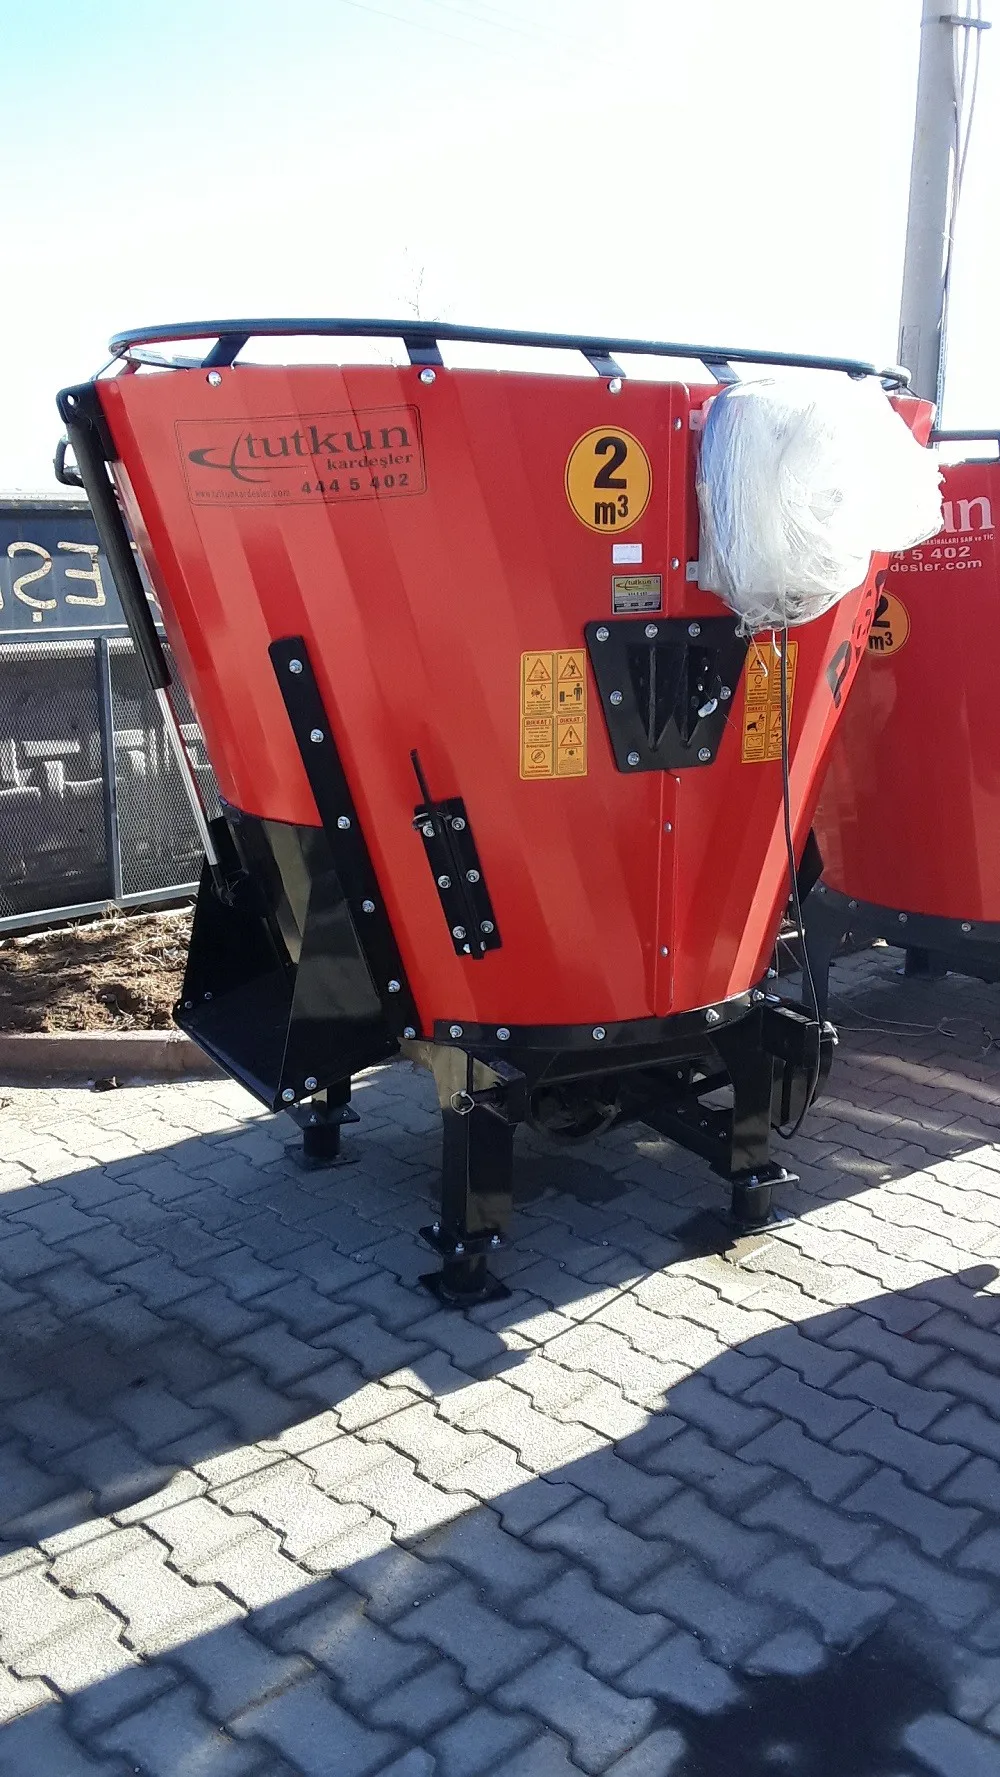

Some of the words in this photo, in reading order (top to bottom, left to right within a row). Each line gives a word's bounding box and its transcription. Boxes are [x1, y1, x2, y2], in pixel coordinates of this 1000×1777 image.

[244, 425, 411, 459] tutkun
[326, 452, 414, 472] kardeşler
[593, 436, 628, 490] 2
[301, 477, 340, 494] 444
[349, 476, 361, 491] 5
[369, 472, 410, 491] 402
[911, 549, 924, 561] 5
[930, 545, 971, 559] 402
[871, 594, 891, 628] 2
